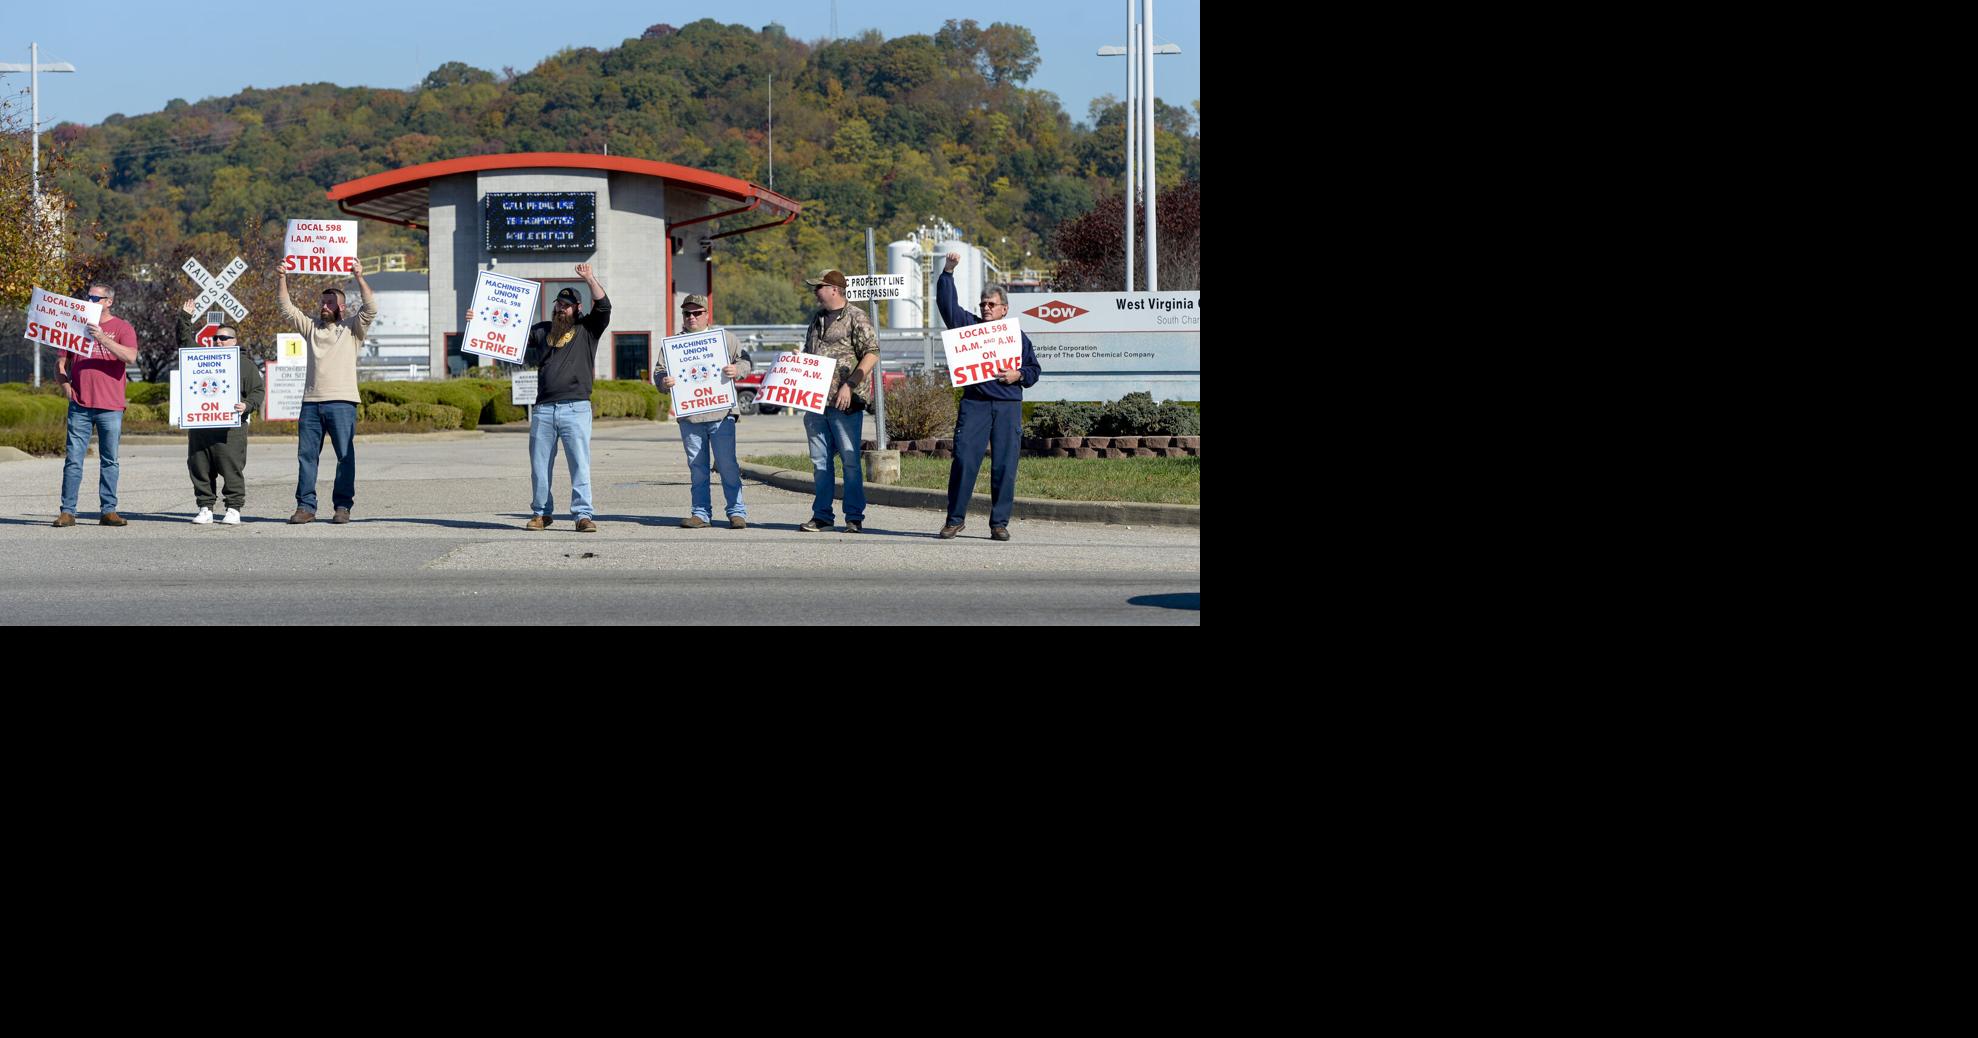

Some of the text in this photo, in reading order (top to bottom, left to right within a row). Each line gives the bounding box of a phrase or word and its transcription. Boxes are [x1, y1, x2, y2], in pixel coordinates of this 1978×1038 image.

[297, 223, 323, 231] LOCAL
[291, 235, 315, 243] I.A.M.
[328, 236, 349, 244] A.W.
[312, 246, 326, 254] ON
[285, 254, 354, 273] STRIKE
[485, 279, 530, 295] MACHINISTS
[851, 277, 887, 287] PROPERTY
[888, 276, 905, 286] LINE
[185, 260, 245, 319] RAIL ROAD
[493, 288, 519, 300] UNION
[852, 288, 900, 298] TRESPASSING
[42, 294, 86, 312] LOCAL 598
[487, 295, 508, 305] LOCAL
[1116, 298, 1145, 310] West
[1148, 297, 1194, 312] Virginia
[36, 304, 58, 317] I.A.M.
[55, 320, 68, 330] ON
[1156, 315, 1179, 325] South
[28, 321, 92, 354] STRIKE
[486, 331, 506, 343] ON
[959, 323, 1008, 340] LOCAL 598
[290, 341, 296, 355] 1
[470, 338, 518, 357] STRIKE!
[671, 337, 718, 351] MACHINISTS
[954, 342, 983, 354] I.A.M.
[998, 335, 1016, 345] A.W.
[683, 346, 708, 355] UNION
[982, 350, 997, 360] ON
[1123, 351, 1155, 359] Company
[679, 355, 700, 363] LOCAL
[776, 355, 819, 367] LOCAL 598
[802, 370, 823, 380] A.W.
[783, 377, 797, 386] ON
[693, 386, 713, 398] ON
[755, 385, 824, 410] STRIKE
[200, 401, 219, 411] ON
[680, 393, 730, 410] STRIKE!
[187, 412, 234, 422] STRIKE!
